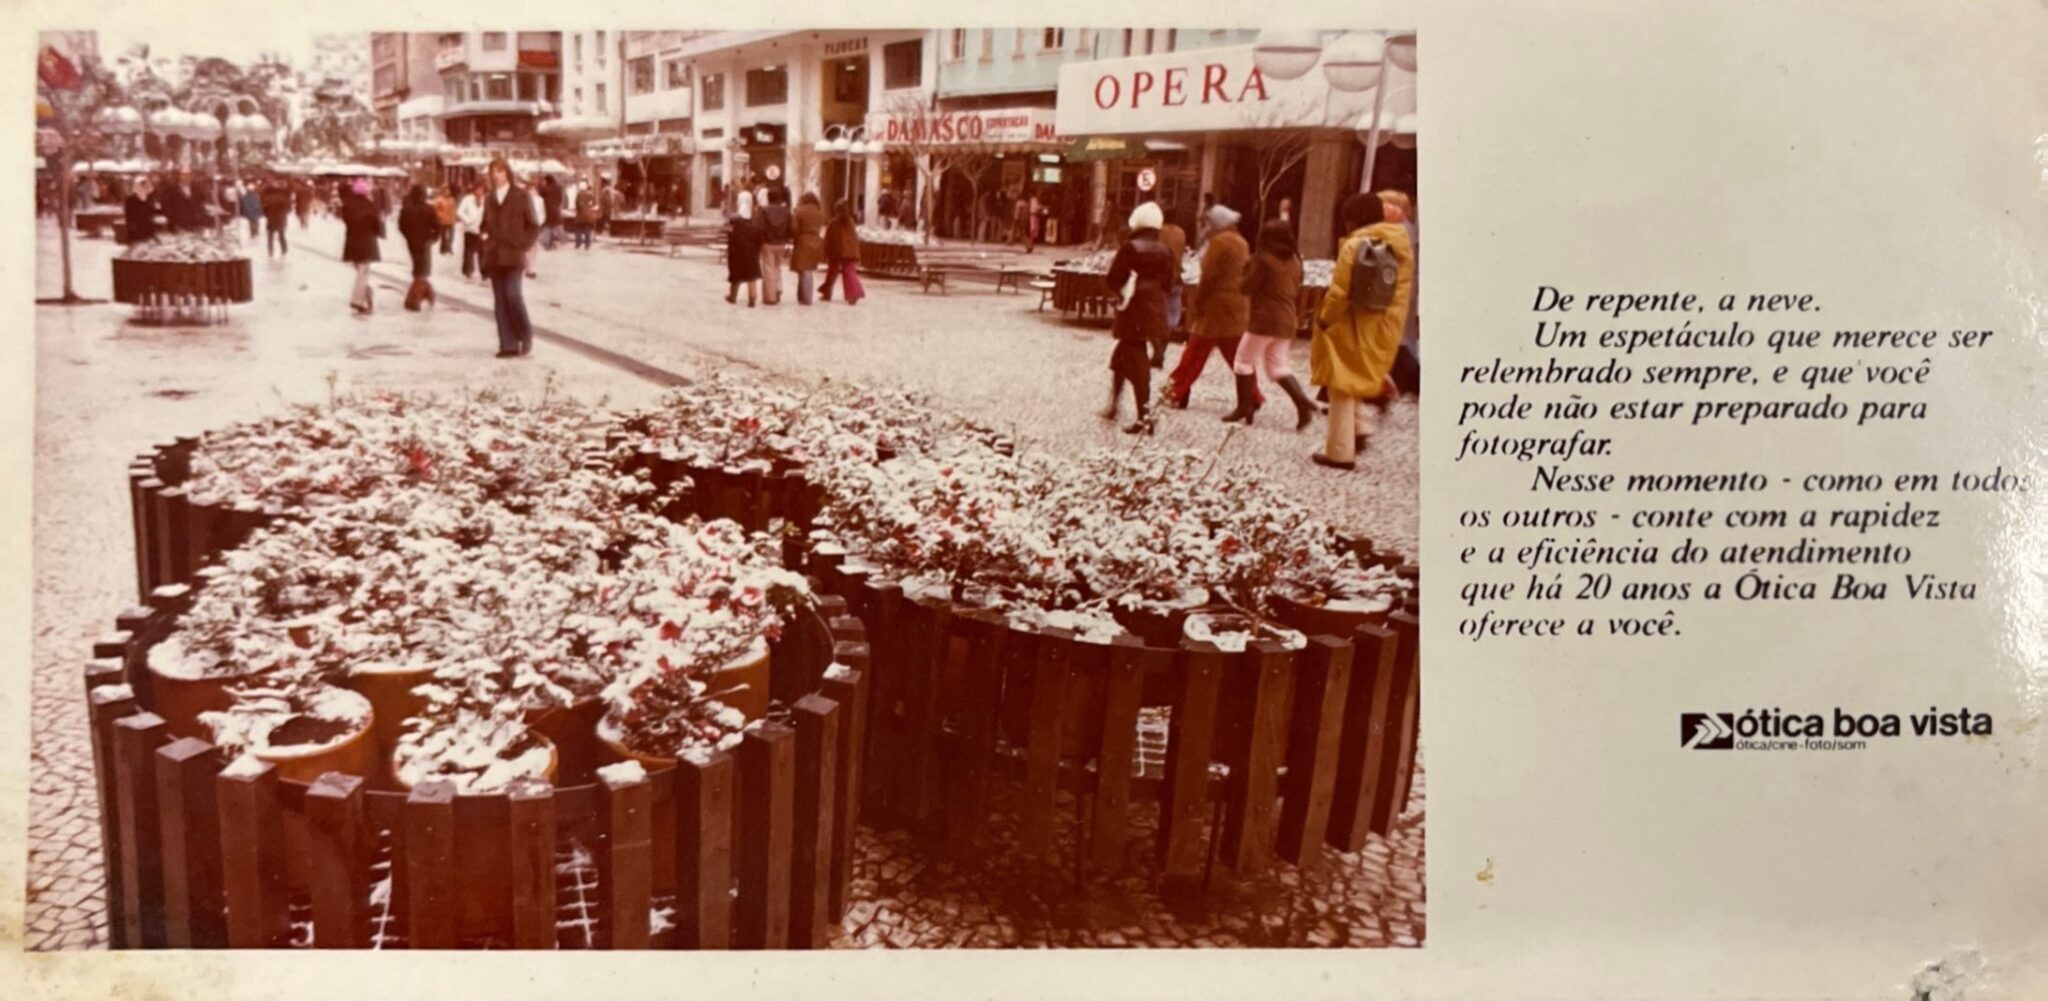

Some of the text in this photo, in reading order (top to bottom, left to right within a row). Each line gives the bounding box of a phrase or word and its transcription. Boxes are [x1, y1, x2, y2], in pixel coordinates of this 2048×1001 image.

[1094, 62, 1271, 110] OPERA
[887, 115, 983, 143] DAMASCO
[1532, 286, 1820, 318] De repente, a neve.
[1535, 320, 1994, 354] Um espetáculo que merece ser
[1460, 357, 1931, 390] relembrado sempre, e que você
[1458, 393, 1927, 426] pode não estar preparado para
[1455, 429, 1611, 462] fotografar.
[1531, 465, 1615, 492] Nesse
[1627, 472, 1768, 492] momento
[1803, 474, 1882, 492] como
[1894, 474, 1938, 491] em
[1460, 510, 1491, 527] os
[1503, 507, 1597, 528] outros
[1632, 508, 1713, 528] conte
[1725, 510, 1787, 528] com
[1799, 510, 1817, 527] a
[1830, 501, 1940, 534] rapidez
[1460, 537, 1911, 570] e a eficiência do atendimento
[1461, 568, 1976, 607] que há 20 anos a Ótica Boa Vista
[1459, 610, 1680, 642] oferece a você.
[1736, 706, 1994, 738] ótica boa vista
